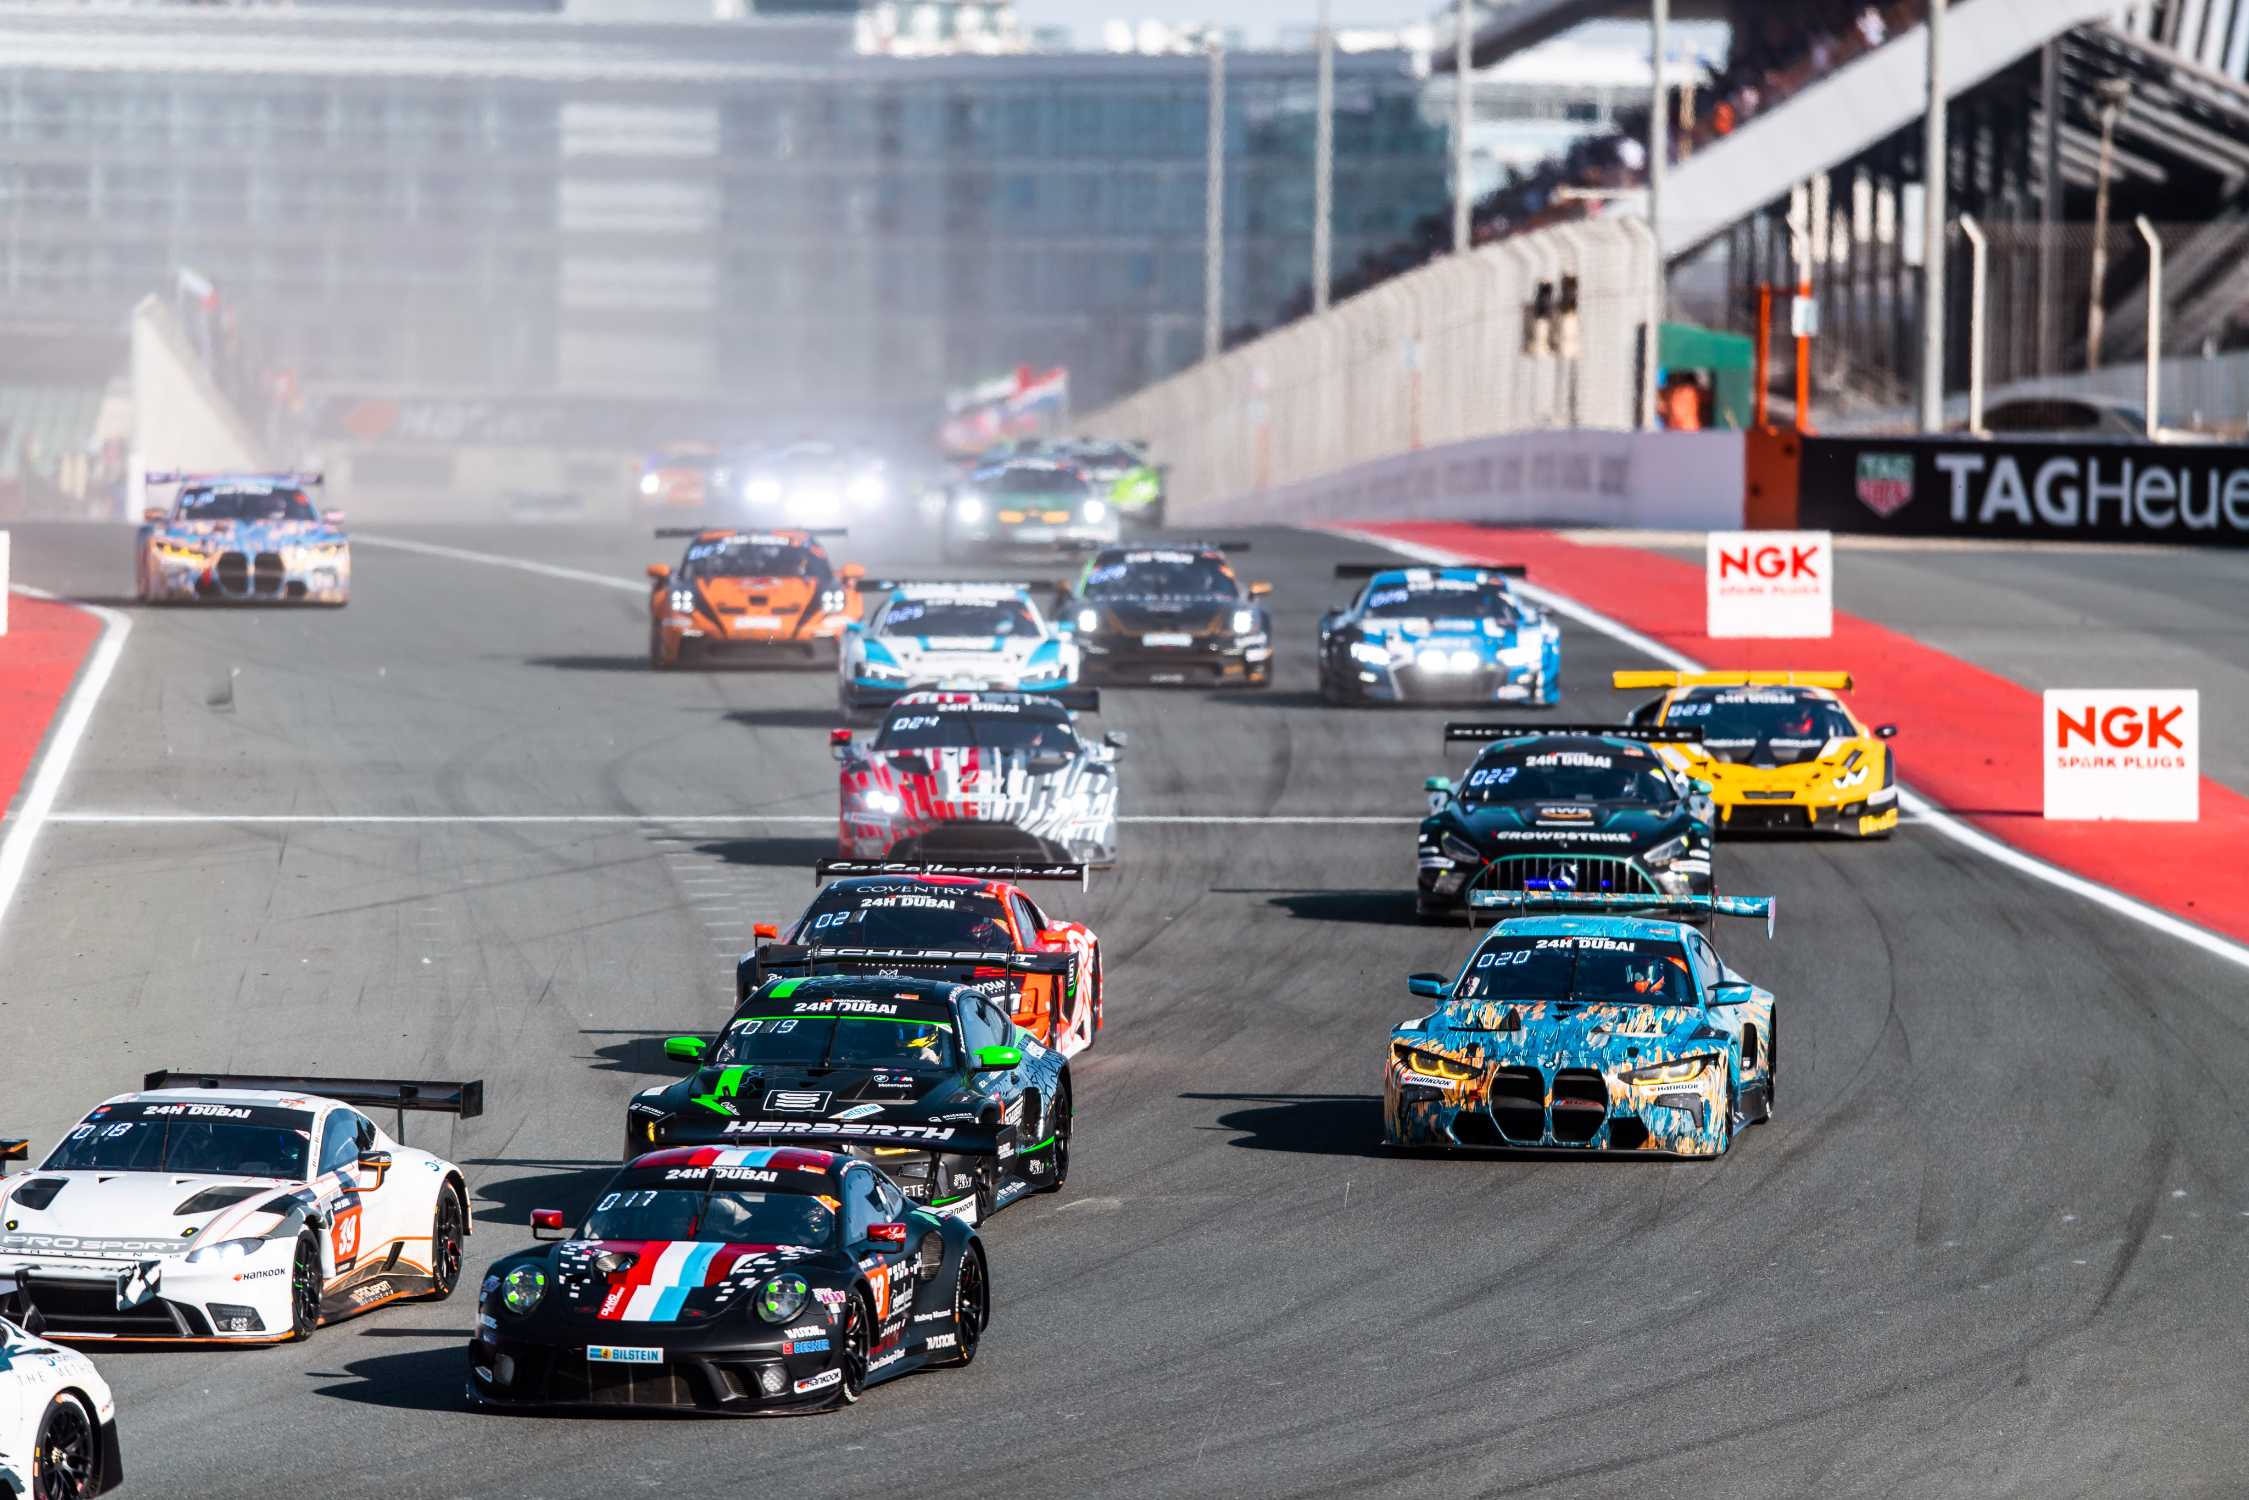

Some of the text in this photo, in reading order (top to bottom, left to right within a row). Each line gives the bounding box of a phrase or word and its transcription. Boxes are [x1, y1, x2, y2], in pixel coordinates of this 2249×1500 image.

[1720, 546, 1818, 578] NGK
[893, 716, 940, 731] 024
[2057, 705, 2184, 749] NGK
[1525, 755, 1612, 769] 24H DUBAI
[2058, 757, 2185, 768] SPARK PLUGS
[1469, 766, 1519, 787] 022
[1497, 830, 1632, 843] CROWDSTRIKE
[856, 885, 968, 896] COVENTRY
[860, 898, 956, 909] 24H DUBAI
[814, 909, 868, 929] 021
[1536, 939, 1636, 952] 24H DUBAI
[808, 948, 1038, 967] SCHUBERT
[1477, 950, 1531, 968] 020
[794, 1002, 899, 1015] 24H DUBAI
[739, 1019, 799, 1035] 019
[143, 1105, 252, 1119] 24H DUBAI
[723, 1120, 956, 1140] HERBERTH
[665, 1169, 779, 1183] 24H DUBAI
[597, 1190, 658, 1212] 017
[2, 1234, 189, 1250] PRO SPORT
[338, 1213, 357, 1256] 39
[612, 1349, 659, 1361] BILSTEIN
